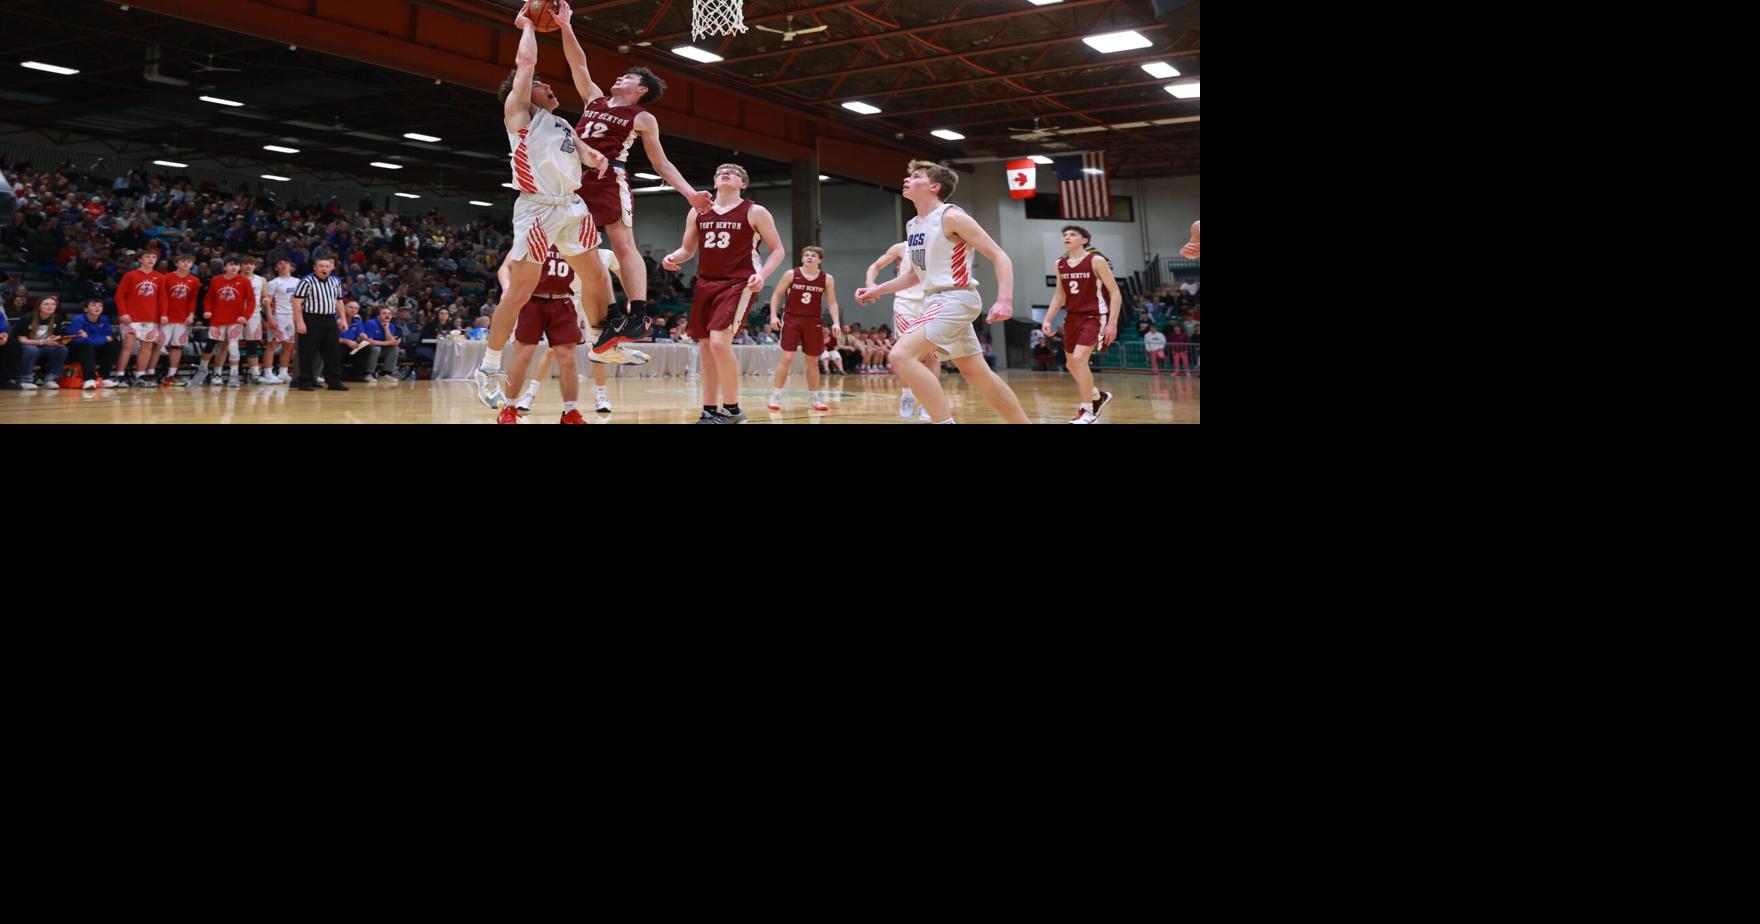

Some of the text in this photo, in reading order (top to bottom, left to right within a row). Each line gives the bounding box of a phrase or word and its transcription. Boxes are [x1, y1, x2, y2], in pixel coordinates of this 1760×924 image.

[598, 112, 630, 127] BENTON
[581, 121, 608, 138] 12
[715, 221, 742, 230] BENTON
[704, 231, 731, 249] 23
[547, 259, 570, 278] 10
[1069, 280, 1080, 294] 2
[800, 292, 812, 304] 3
